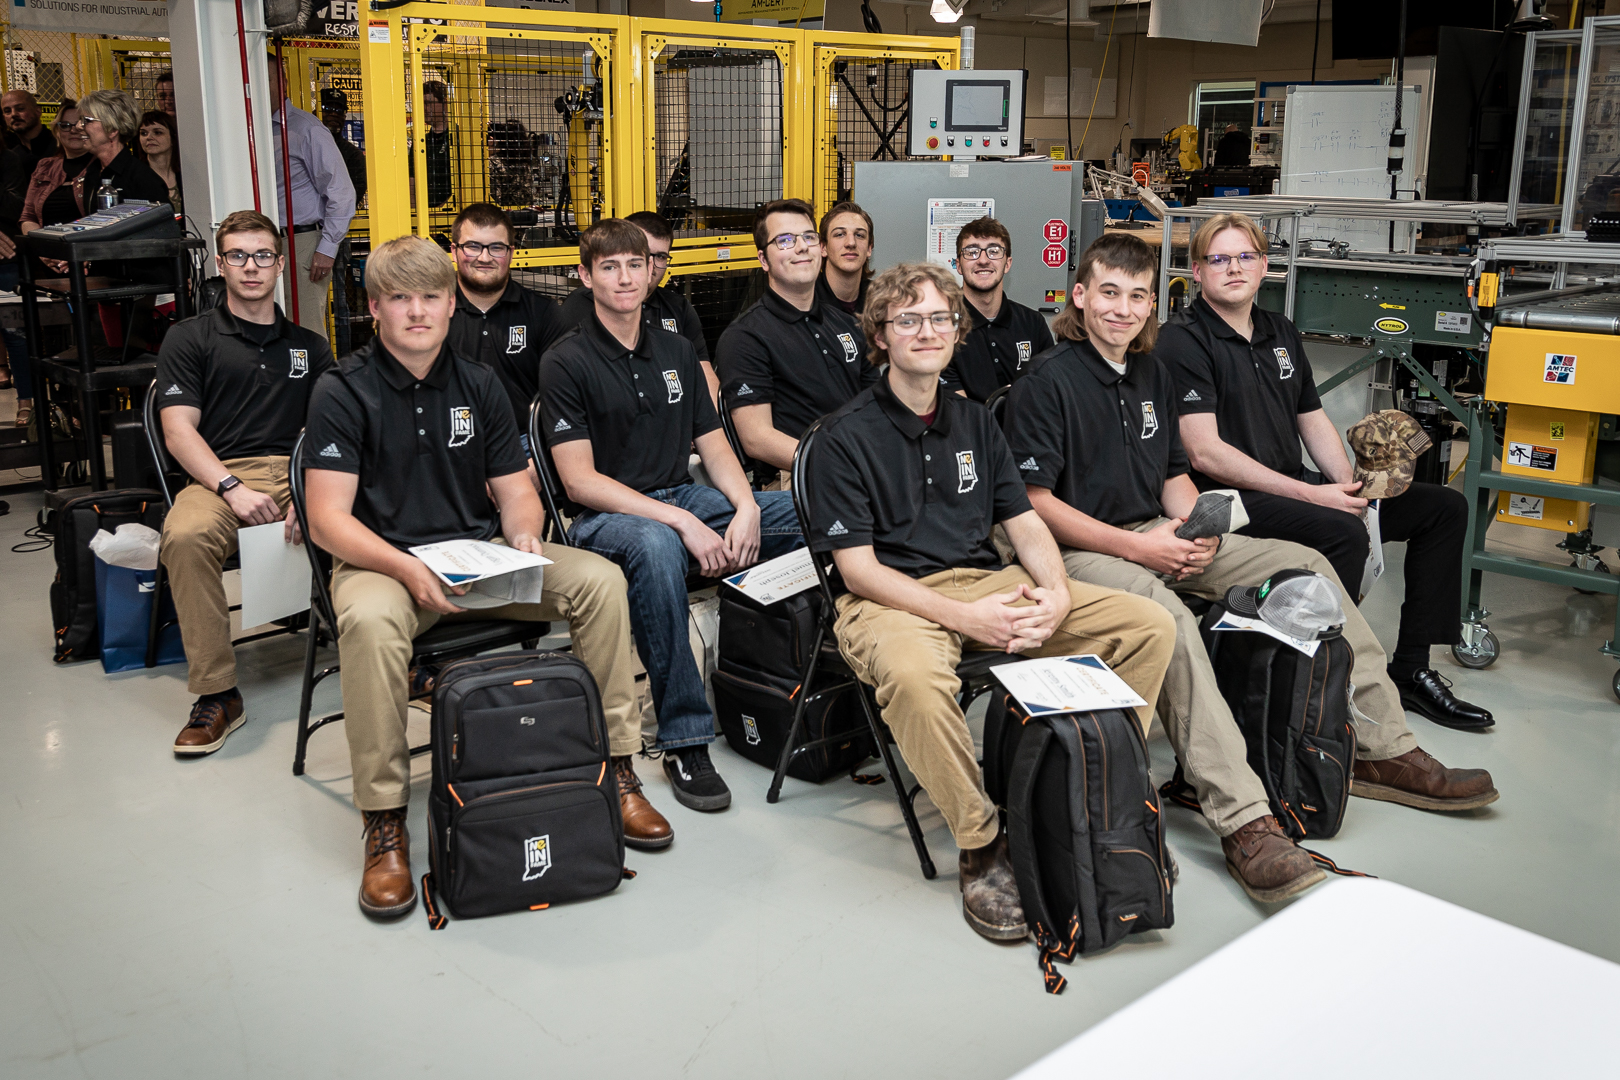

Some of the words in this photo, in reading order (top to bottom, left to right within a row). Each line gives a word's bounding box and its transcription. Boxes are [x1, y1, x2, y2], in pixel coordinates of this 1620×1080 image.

[31, 0, 80, 12] SOLUTIONS
[82, 4, 98, 13] FOR
[100, 6, 150, 16] INDUSTRIAL
[1050, 226, 1062, 237] E1
[1048, 251, 1061, 261] H1
[512, 334, 523, 342] IN
[294, 358, 305, 366] IN
[1547, 365, 1575, 373] AMTEC
[668, 380, 679, 389] IN
[455, 419, 470, 430] IN
[320, 451, 342, 459] adidas
[961, 463, 973, 475] IN
[530, 849, 546, 862] IN
